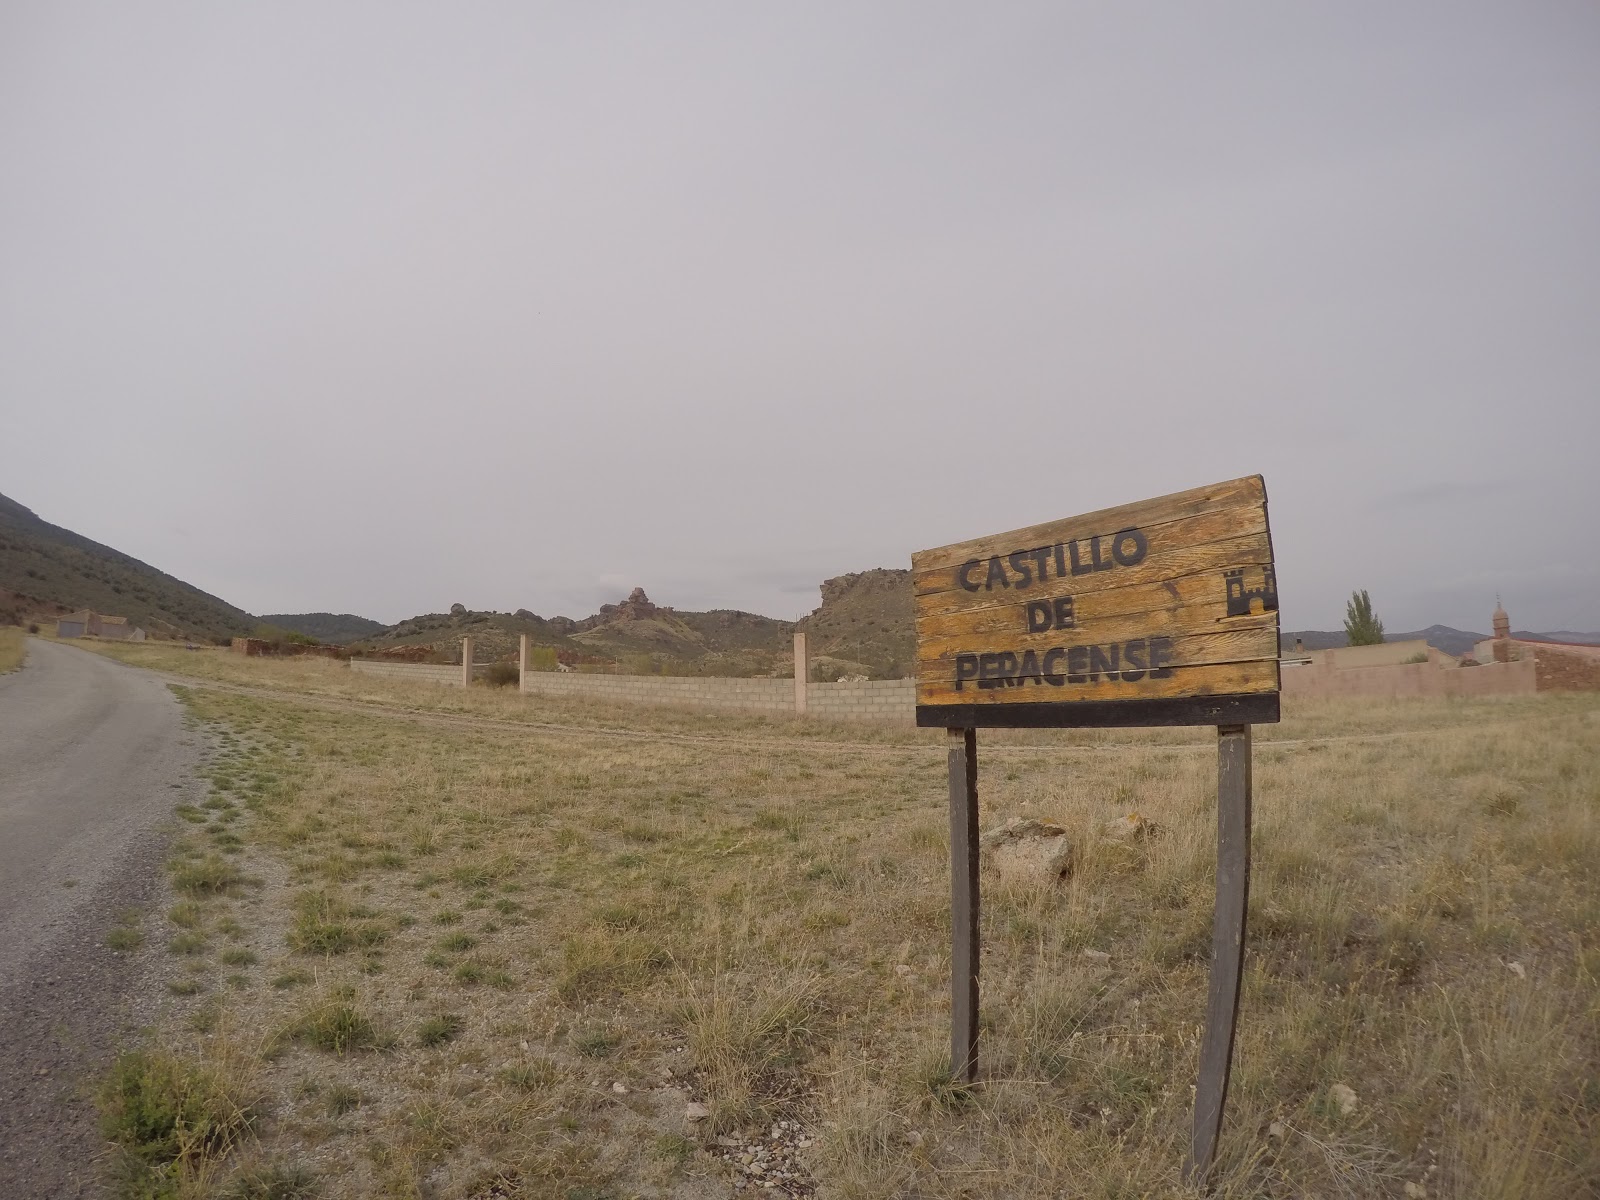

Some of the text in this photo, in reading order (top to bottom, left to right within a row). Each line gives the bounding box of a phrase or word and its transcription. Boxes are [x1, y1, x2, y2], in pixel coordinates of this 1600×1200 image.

[960, 527, 1147, 592] CASTILLO
[1027, 598, 1074, 633] DE
[955, 638, 1174, 690] PERACENSE
